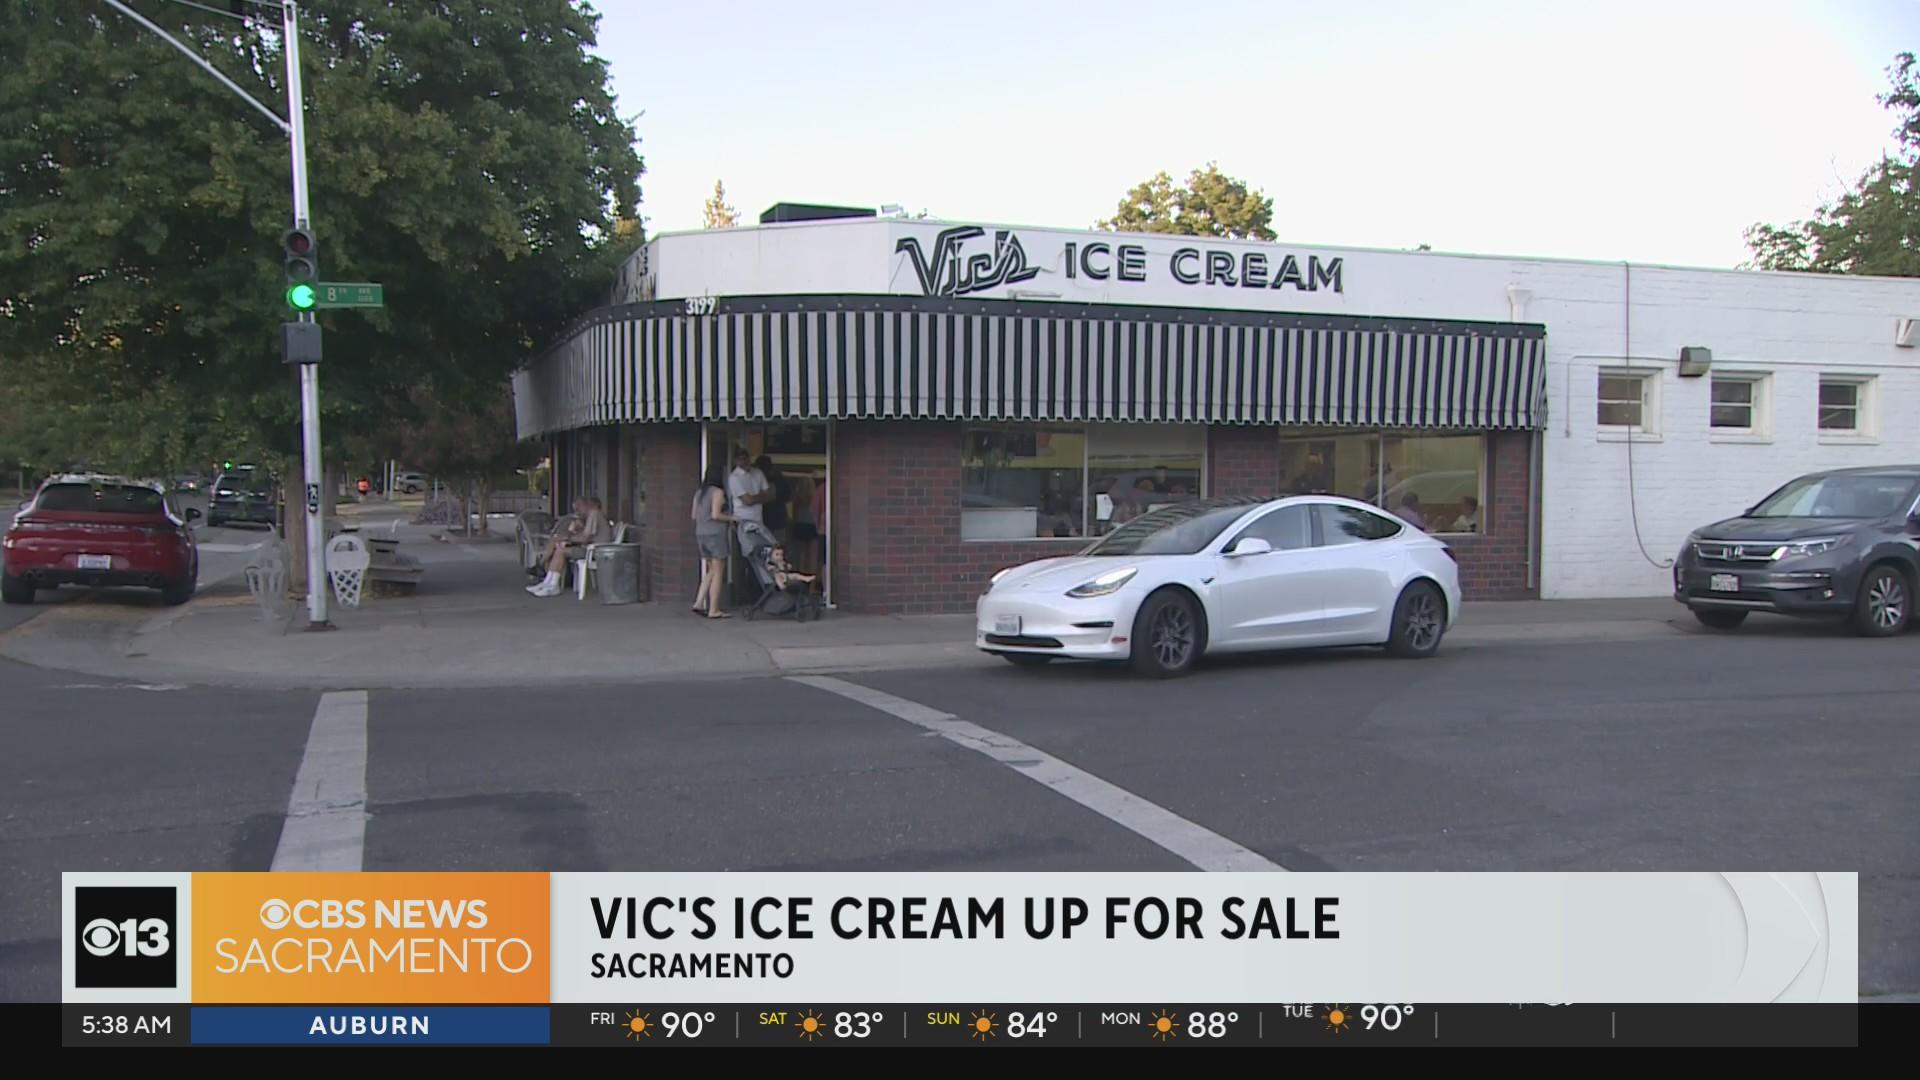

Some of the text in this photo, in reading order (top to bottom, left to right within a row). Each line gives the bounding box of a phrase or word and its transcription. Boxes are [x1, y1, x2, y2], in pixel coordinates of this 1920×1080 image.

[895, 226, 1344, 297] Vic's ICE CREAM
[685, 297, 716, 315] 3199
